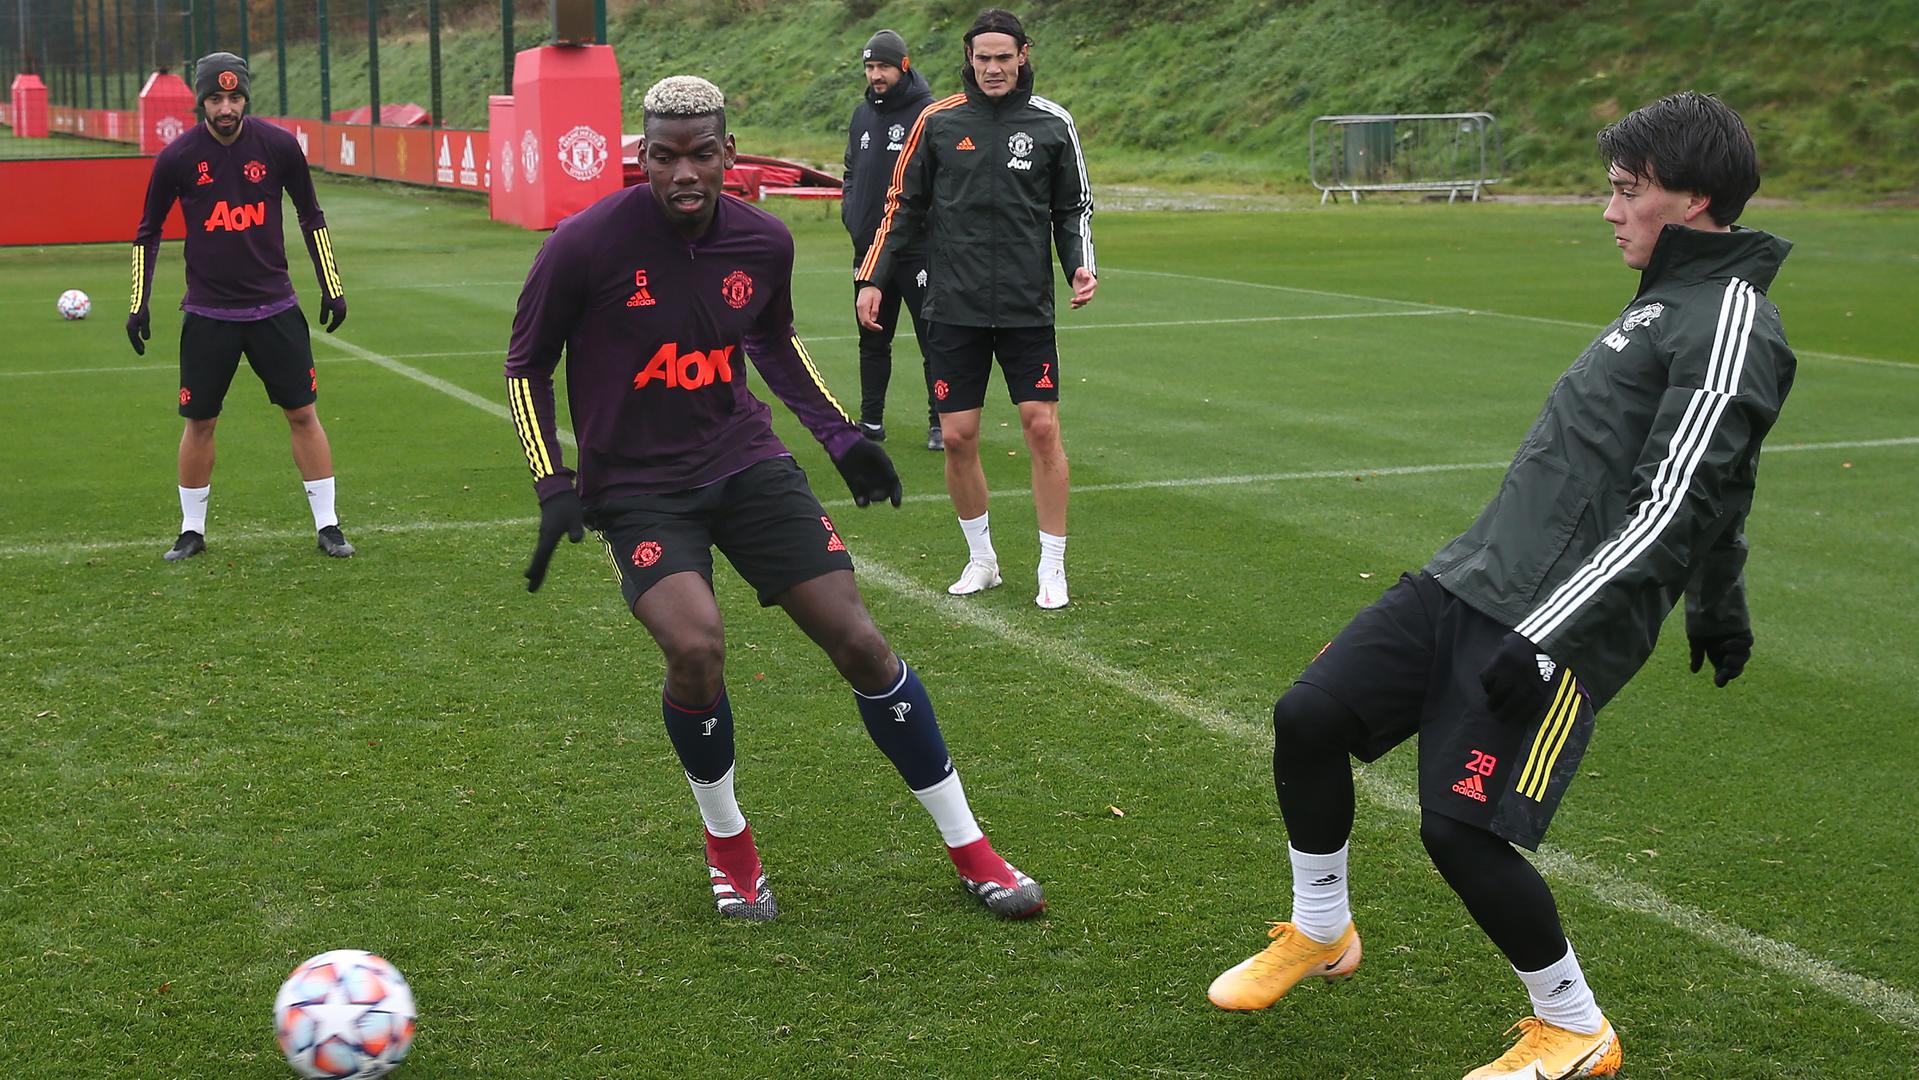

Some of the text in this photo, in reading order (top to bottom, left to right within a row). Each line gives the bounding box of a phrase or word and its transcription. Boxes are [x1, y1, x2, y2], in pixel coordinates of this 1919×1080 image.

[197, 161, 209, 173] 18
[635, 269, 648, 287] 6
[626, 298, 656, 307] adidas
[1042, 363, 1050, 375] 7
[820, 516, 834, 532] 6
[1465, 749, 1497, 777] 28
[1452, 784, 1487, 802] adidas
